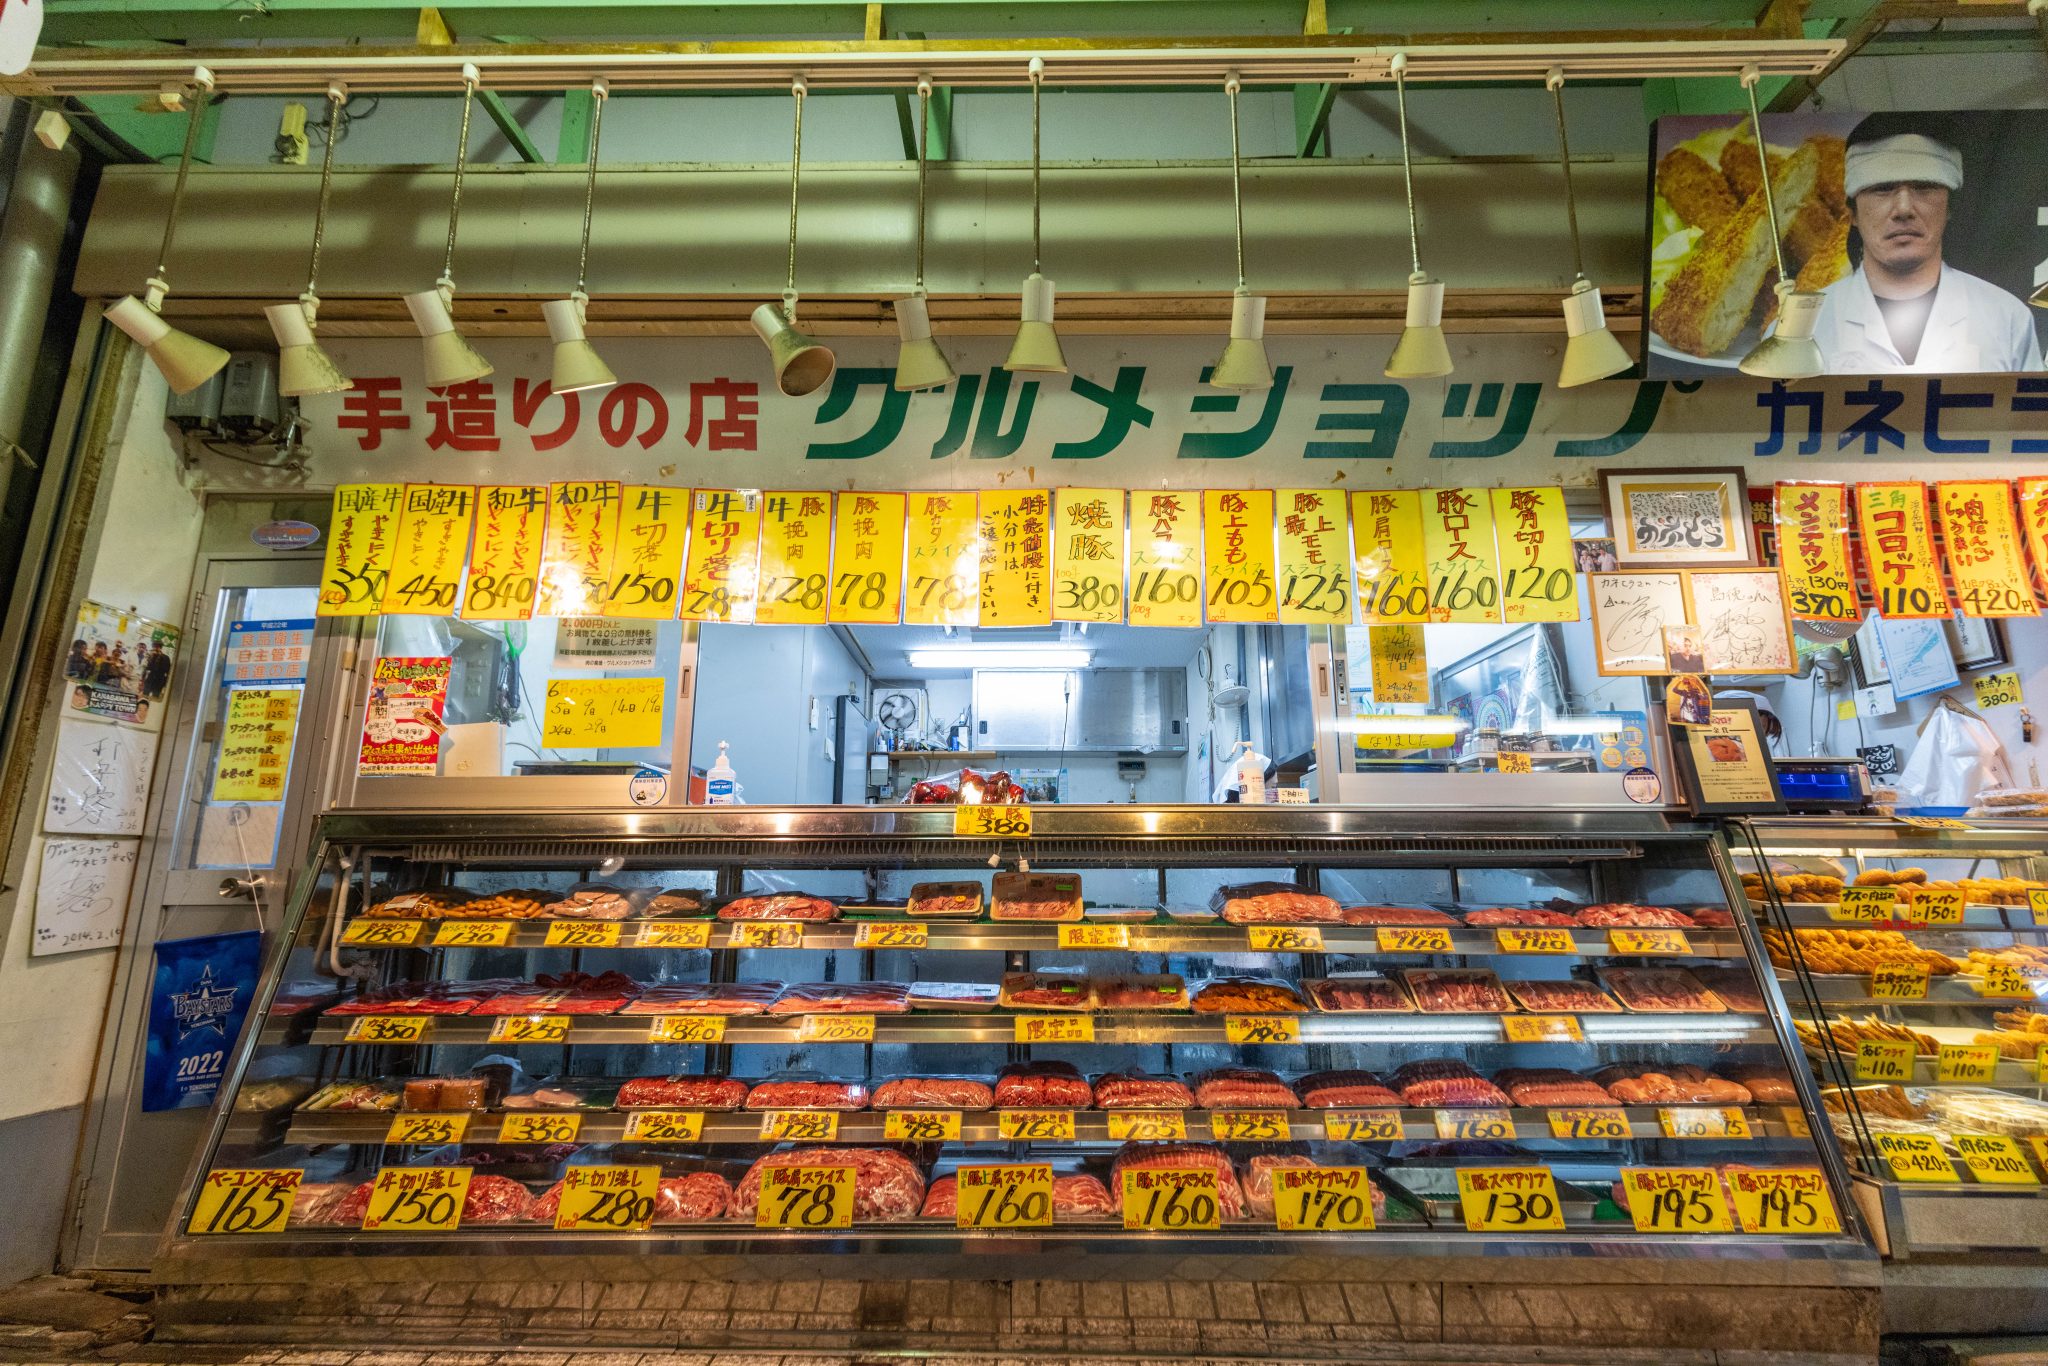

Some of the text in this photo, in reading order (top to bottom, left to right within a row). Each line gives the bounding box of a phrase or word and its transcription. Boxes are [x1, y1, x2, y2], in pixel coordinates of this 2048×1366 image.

[338, 377, 759, 451] 手造りの店
[805, 366, 1704, 459] グルメショップ
[338, 487, 402, 513] 国産牛
[408, 488, 473, 516] 国産牛
[488, 487, 547, 512] 和牛
[556, 482, 619, 507] 和牛
[1868, 490, 1906, 509] 三角
[1067, 499, 1114, 561] 焼豚
[1148, 494, 1186, 542] 豚バラ
[1220, 493, 1249, 564] 豚上もも
[1437, 488, 1478, 561] 豚ロース
[1510, 490, 1545, 567] 豚角切り
[1370, 494, 1399, 573] 豚肩ロース
[1794, 491, 1828, 574] メンチカツ
[1873, 511, 1915, 585] コロッケ
[397, 574, 458, 607] 450
[469, 573, 535, 611] 840
[610, 573, 674, 604] 150
[760, 573, 826, 610] 128
[835, 571, 887, 610] 78
[913, 574, 967, 610] 78
[1057, 575, 1120, 612] 380
[1132, 567, 1198, 604] 160
[1209, 569, 1272, 607] 105
[1282, 573, 1349, 614] 125
[1365, 574, 1430, 616] 160
[1431, 569, 1498, 611] 160
[1505, 566, 1573, 601] 120
[1883, 587, 1948, 614] 110円
[1964, 588, 2036, 614] 420円
[241, 631, 304, 647] 食品衛生
[238, 647, 302, 663] 自主管理
[235, 663, 300, 679] 推進の店
[91, 691, 130, 703] KANAGAWA
[114, 704, 137, 713] TOWN
[975, 819, 1030, 834] 380
[1854, 904, 1880, 918] 130
[1924, 906, 1950, 920] 150
[448, 932, 497, 944] 130
[559, 931, 607, 945] 120
[1267, 932, 1319, 949] 180
[1394, 934, 1447, 949] 140
[1635, 941, 1682, 952] 120
[175, 994, 234, 1017] BAYSTARS
[368, 1023, 417, 1040] 350
[670, 1024, 717, 1041] 840
[820, 1026, 870, 1038] 1050
[1026, 1019, 1083, 1040] 限定品
[177, 1050, 224, 1076] 2022
[1862, 1045, 1906, 1058] あじフライ
[1944, 1049, 1991, 1060] いかフライ
[400, 1124, 451, 1142] 155
[513, 1124, 574, 1141] 350
[644, 1125, 692, 1139] 200
[780, 1123, 831, 1138] 128
[904, 1121, 945, 1138] 78
[1013, 1120, 1068, 1137] 160
[1126, 1120, 1177, 1139] 105
[1225, 1119, 1281, 1139] 125
[1345, 1120, 1398, 1139] 150
[1455, 1119, 1506, 1139] 160
[1572, 1117, 1624, 1138] 160
[1880, 1137, 1932, 1152] 肉だんご
[1959, 1138, 2007, 1153] 肉だんご
[1911, 1155, 1941, 1172] 420
[1989, 1157, 2019, 1173] 210
[207, 1171, 302, 1189] ベーコンスライス
[378, 1169, 462, 1192] 牛切り落し
[1471, 1173, 1547, 1191] 豚スペアリブ
[207, 1185, 291, 1232] 165
[381, 1189, 456, 1225] 150
[577, 1188, 655, 1227] 280
[776, 1184, 836, 1226] 78
[973, 1184, 1049, 1226] 160
[1143, 1186, 1215, 1227] 160
[1297, 1189, 1363, 1228] 170
[1483, 1192, 1554, 1225] 130
[1651, 1188, 1714, 1228] 195
[1759, 1188, 1818, 1228] 195
